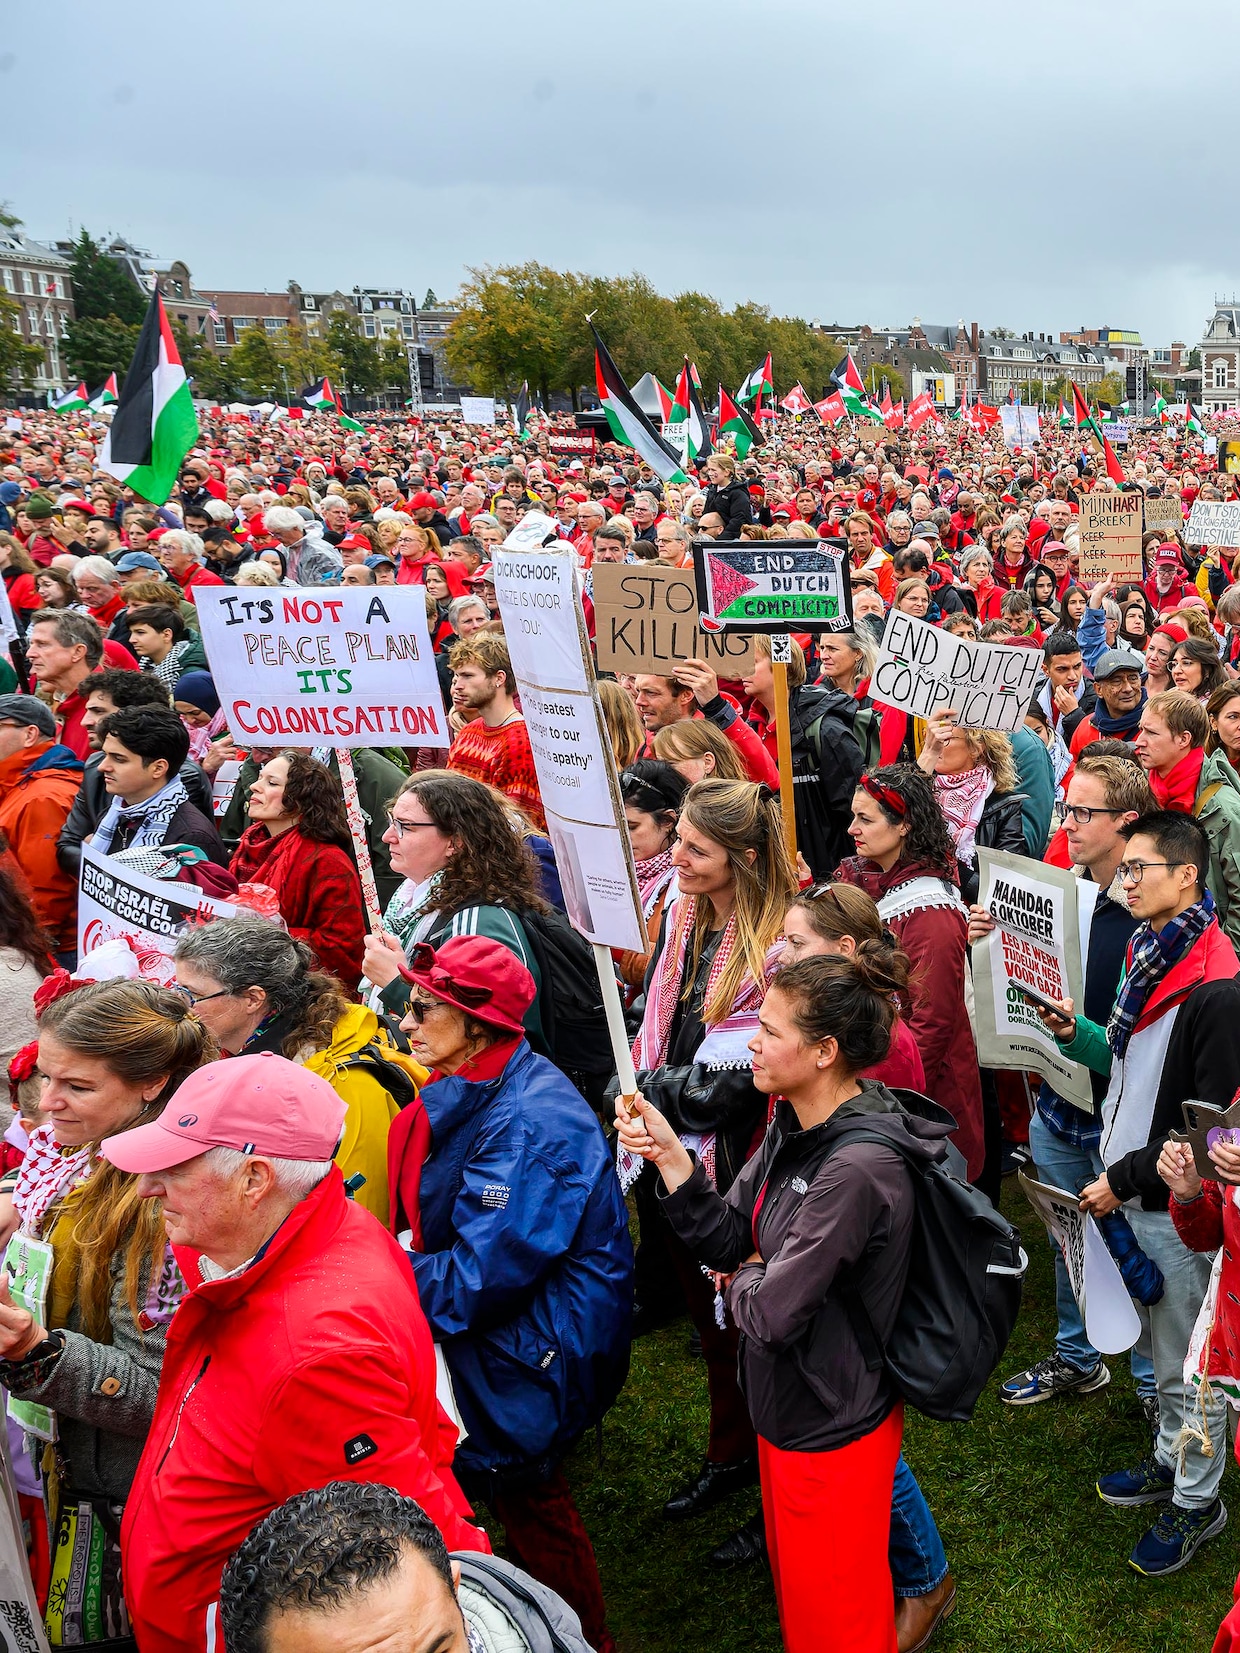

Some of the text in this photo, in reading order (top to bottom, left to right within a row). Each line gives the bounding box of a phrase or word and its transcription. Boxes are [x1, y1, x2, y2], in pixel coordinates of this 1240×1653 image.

[663, 425, 683, 434] FREE
[1113, 495, 1142, 513] HART
[1193, 503, 1221, 517] DON'T
[1089, 514, 1133, 528] BREEKT
[1191, 516, 1220, 528] TALKING
[1081, 532, 1105, 543] KEER
[1187, 527, 1240, 545] PALESTINE
[820, 543, 843, 556] STOP
[1083, 549, 1107, 560] KEER
[754, 555, 795, 572] END
[497, 562, 560, 584] DICK SCHOOF,
[1084, 568, 1108, 578] KEER
[771, 575, 830, 592] DUTCH
[520, 592, 529, 607] IS
[529, 592, 561, 610] VOOR
[621, 576, 694, 613] STO
[283, 596, 343, 624] NOT
[365, 596, 390, 625] A
[744, 600, 838, 617] COMPLICITY
[831, 615, 850, 631] NU!
[611, 616, 753, 660] KILLING
[243, 632, 419, 666] PEACE PLAN
[887, 616, 1041, 688] END DUTCH
[296, 668, 353, 693] IT'S
[876, 662, 1031, 731] COMPLICITY
[232, 700, 440, 736] COLONISATION
[538, 701, 576, 717] greatest
[549, 726, 560, 740] to
[562, 728, 580, 742] our
[552, 772, 580, 788] Goodall
[84, 864, 172, 921] STOP ISRAËL
[993, 879, 1054, 919] MAANDAG
[83, 878, 188, 939] BOYCOT COCA COLA
[989, 901, 997, 917] 6
[999, 904, 1053, 939] OKTOBER
[1001, 930, 1020, 951] LEG
[1020, 940, 1032, 956] JE
[1031, 944, 1060, 972] WERK
[1004, 961, 1036, 988] VOOR
[1036, 975, 1064, 1002] GAZA
[1041, 964, 1063, 987] NEER
[1007, 1003, 1036, 1020] DAT DE
[69, 1516, 88, 1598] METROPOLIS
